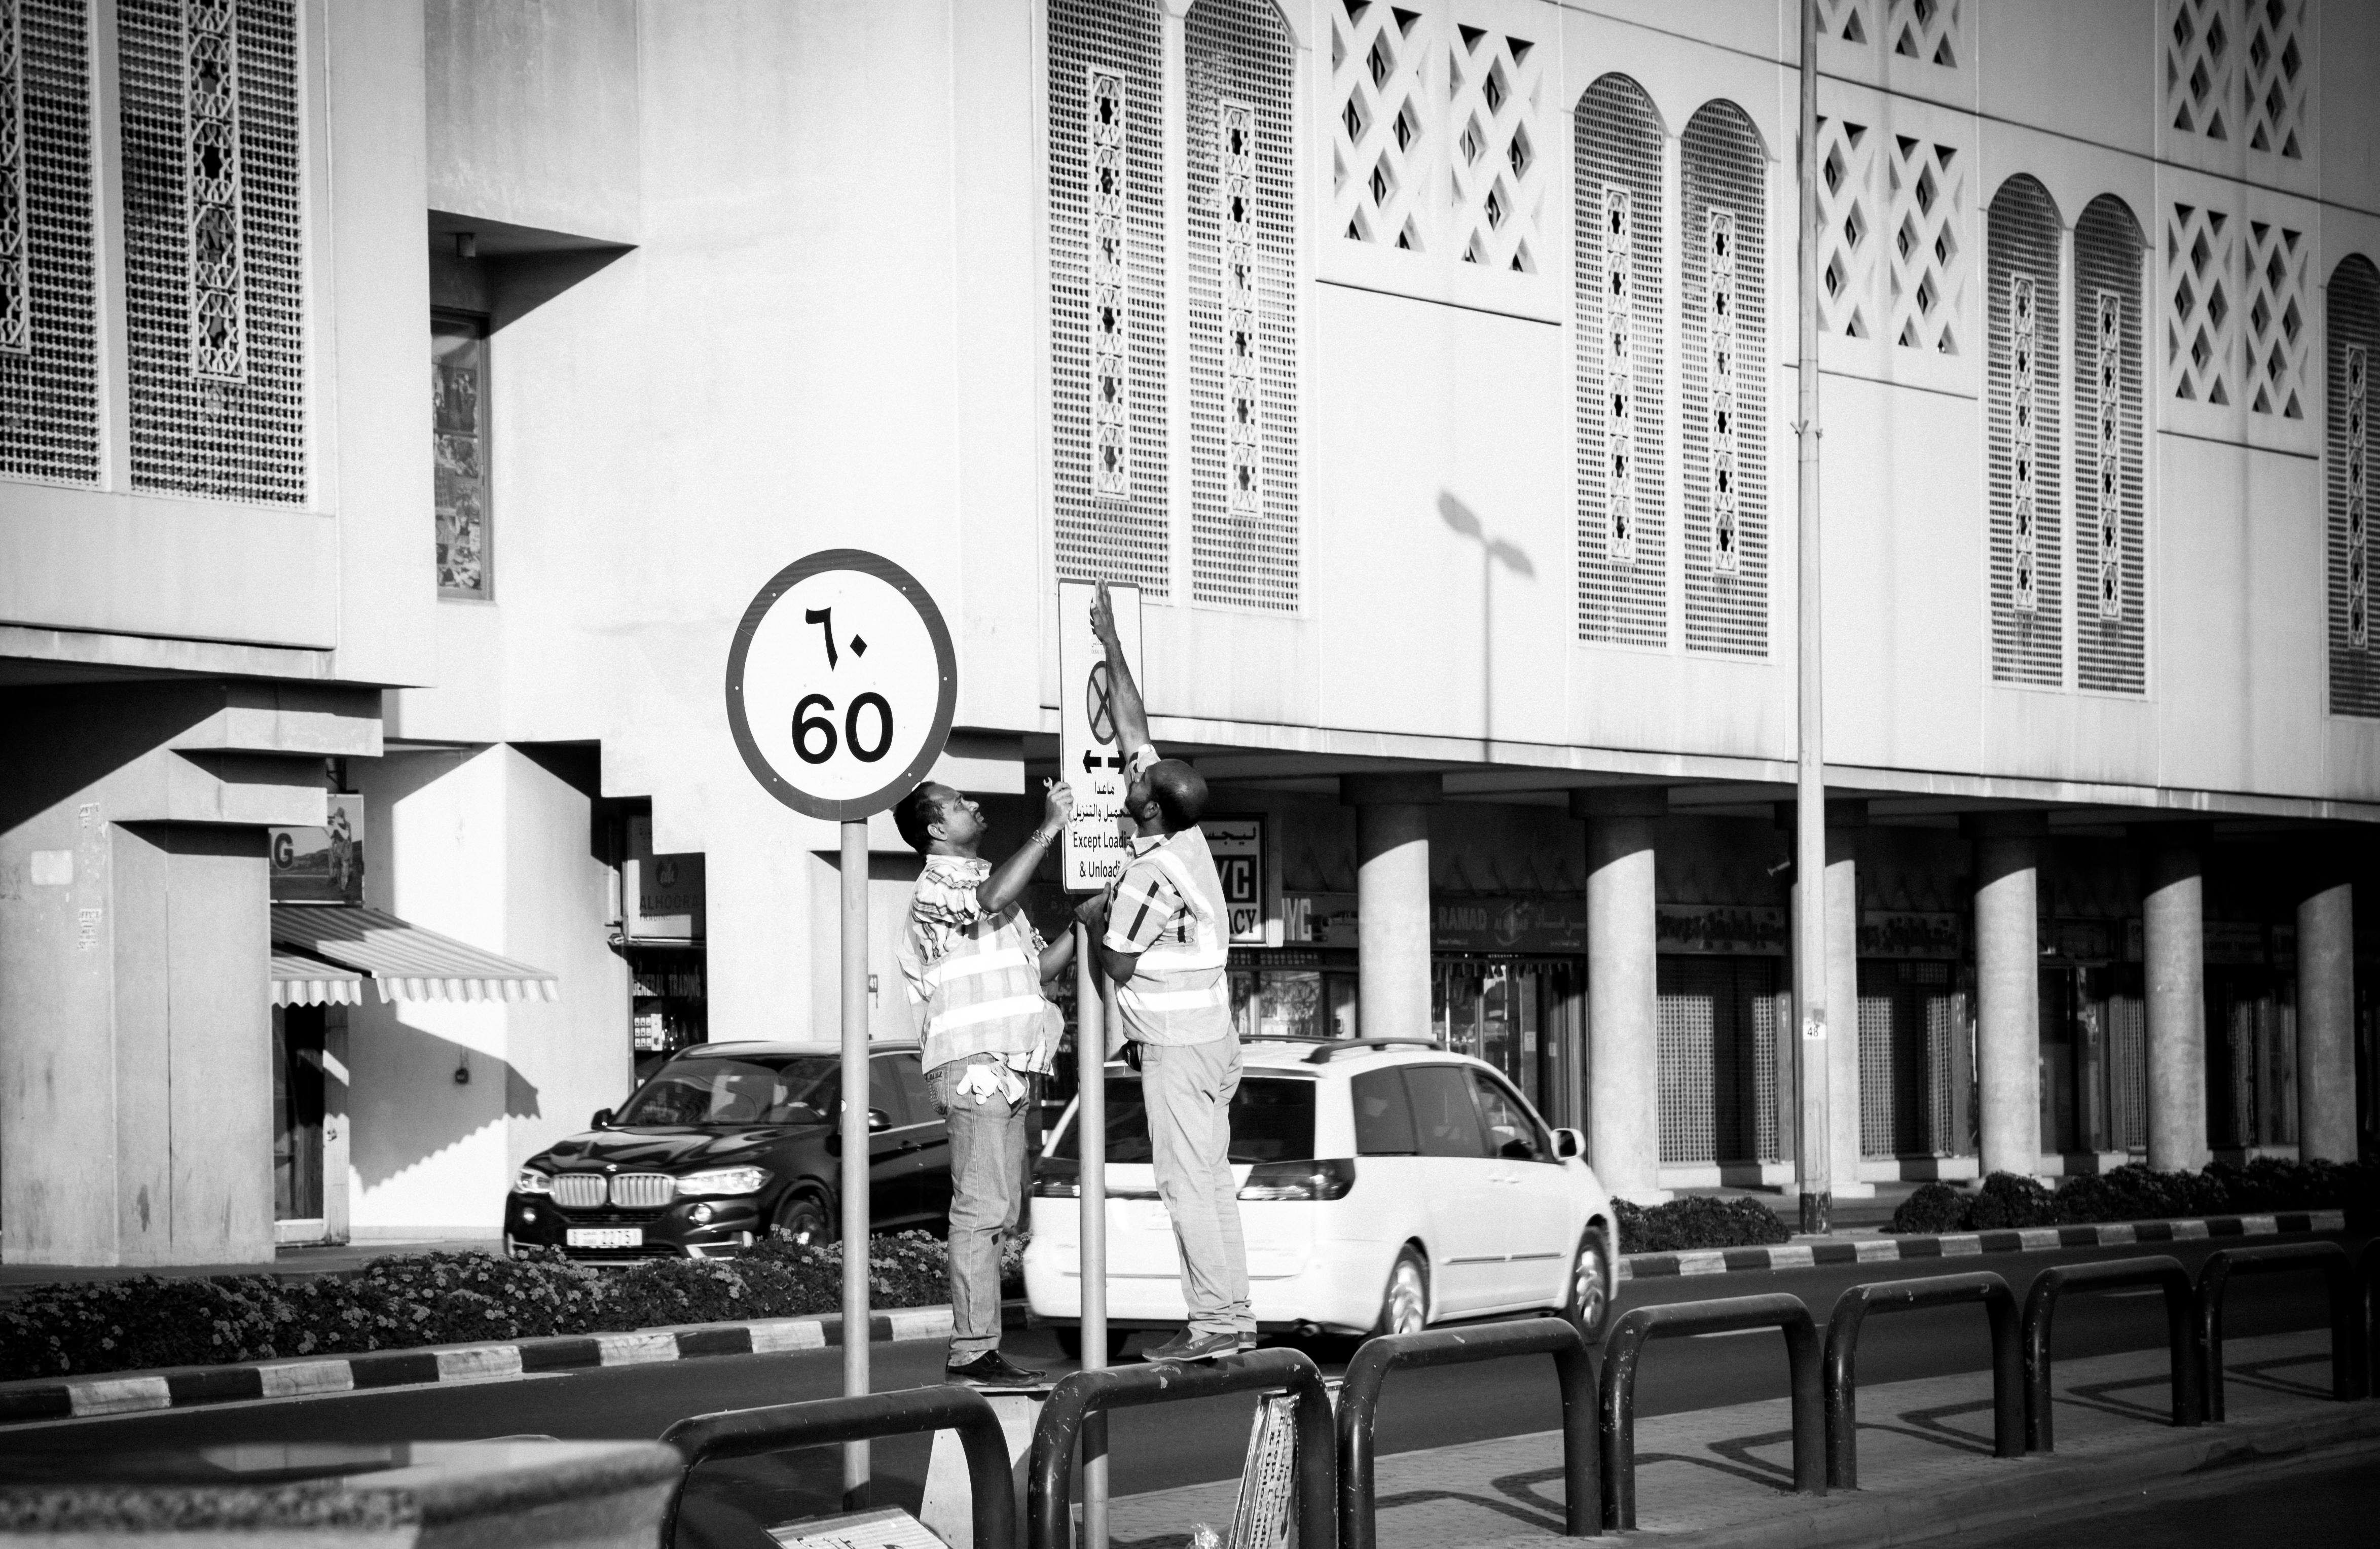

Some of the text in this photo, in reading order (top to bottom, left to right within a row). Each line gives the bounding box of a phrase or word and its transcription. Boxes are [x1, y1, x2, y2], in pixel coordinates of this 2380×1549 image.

[805, 606, 868, 672] ٦٠
[792, 692, 894, 765] 60
[1094, 780, 1115, 795] ماعدا
[274, 833, 294, 870] G
[1073, 830, 1131, 852] Except Loadi
[1080, 860, 1120, 878] & Unloadi
[1807, 1026, 1819, 1037] 48
[1270, 1415, 1285, 1482] Except
